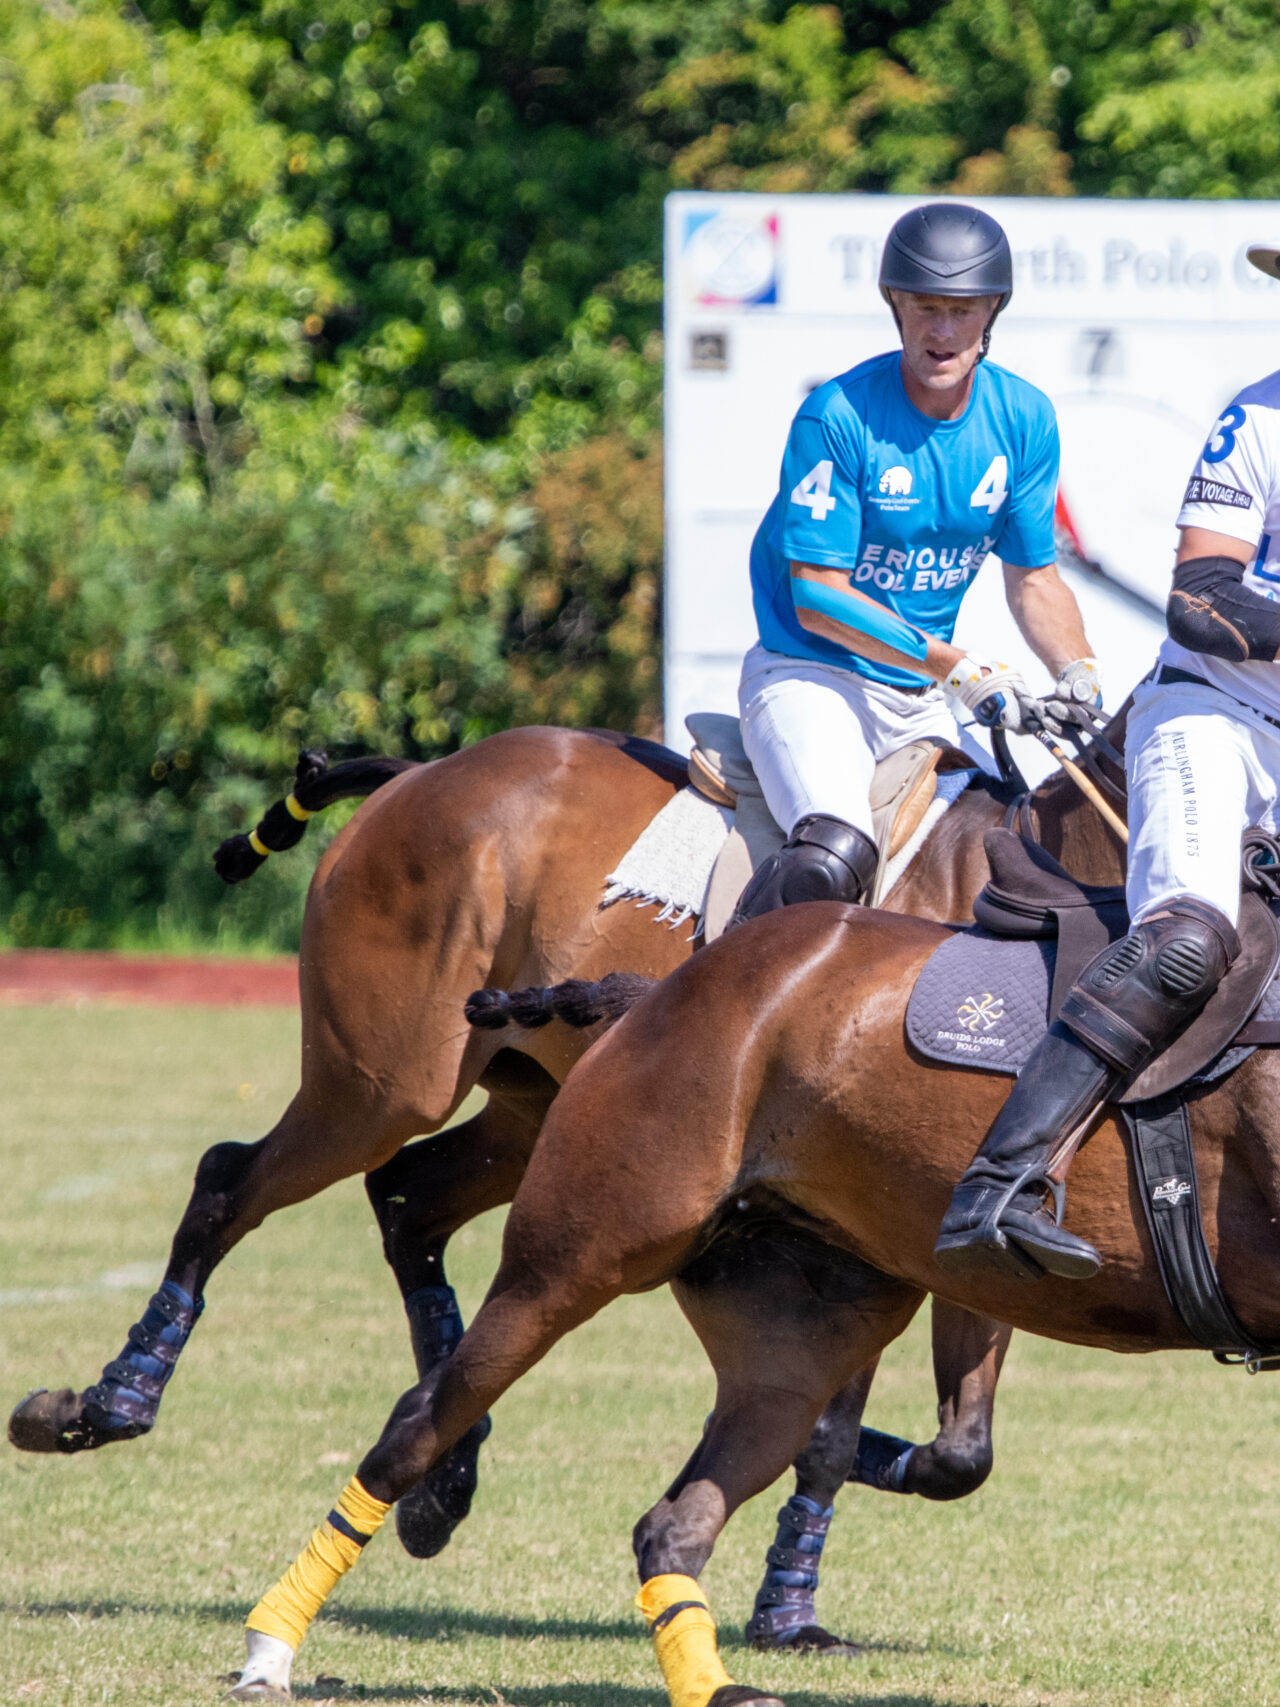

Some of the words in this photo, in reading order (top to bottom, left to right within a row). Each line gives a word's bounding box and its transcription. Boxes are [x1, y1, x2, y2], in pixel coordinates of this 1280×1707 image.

[1102, 237, 1219, 288] Polo
[1081, 328, 1114, 374] 7
[1202, 405, 1246, 463] 3
[790, 459, 836, 521] 4
[969, 455, 1008, 515] 4
[1201, 481, 1236, 503] VOYAGE
[849, 562, 906, 592] OOL
[1184, 799, 1198, 825] POLO
[937, 1030, 971, 1042] DRUIDS
[973, 1035, 1006, 1047] LODGE
[956, 1041, 981, 1052] POLO
